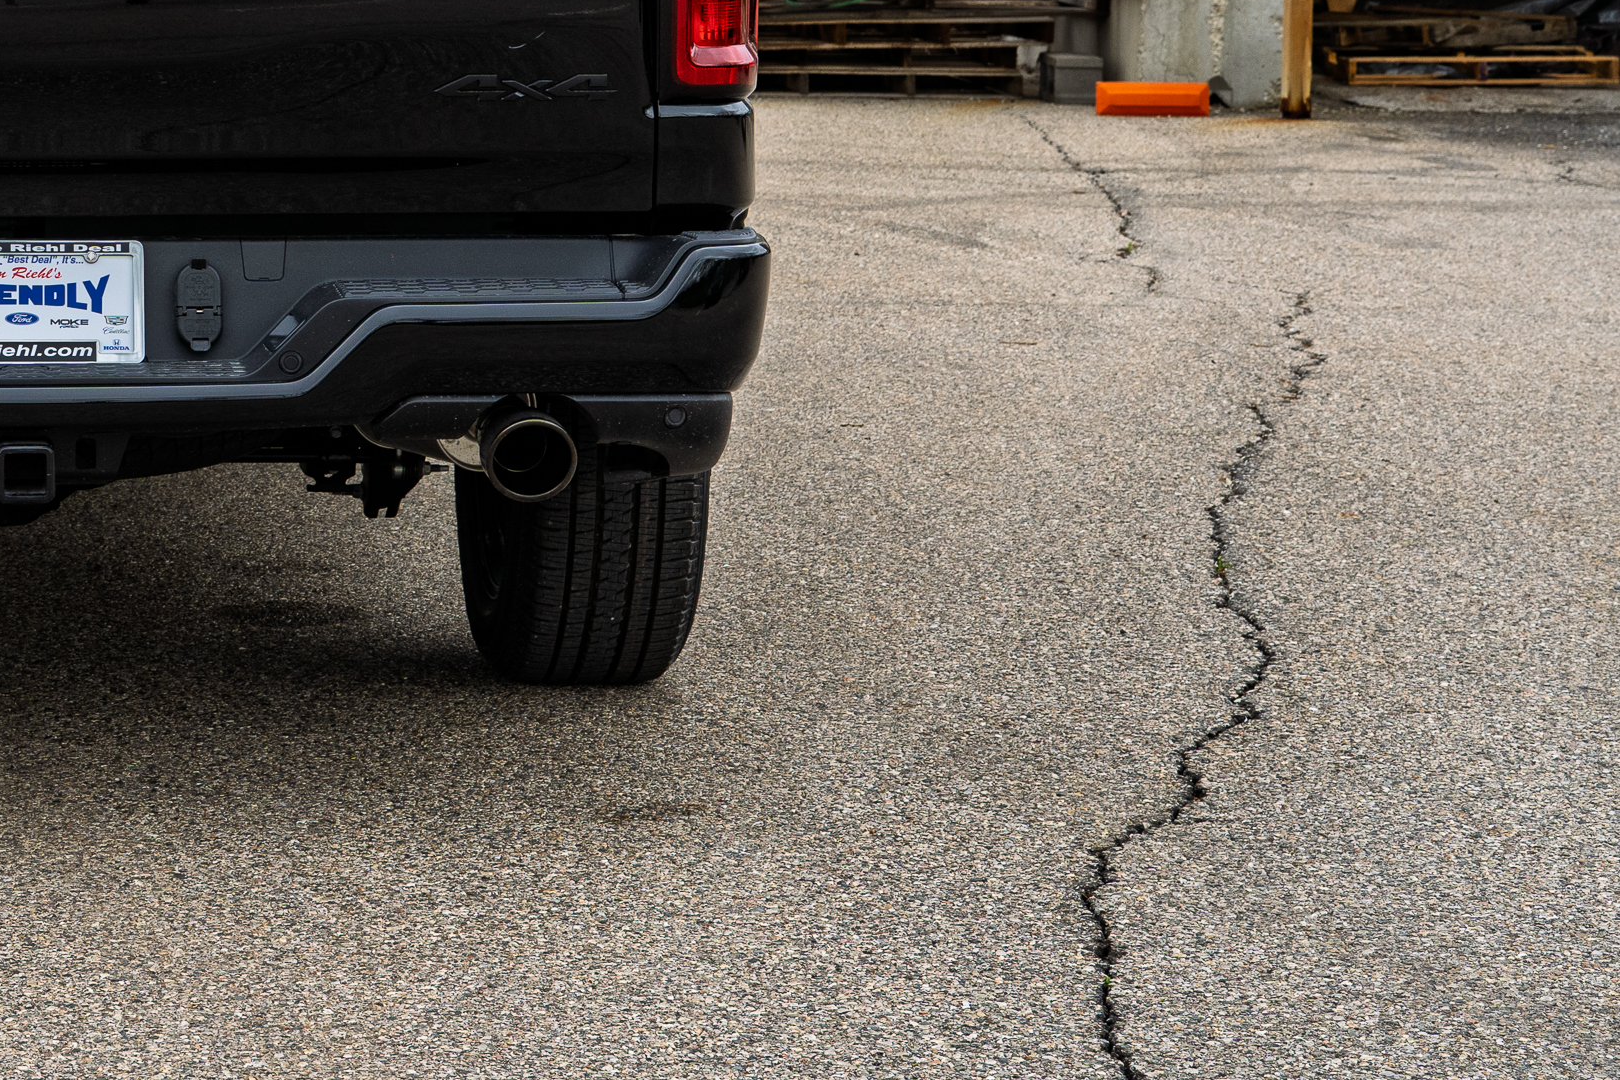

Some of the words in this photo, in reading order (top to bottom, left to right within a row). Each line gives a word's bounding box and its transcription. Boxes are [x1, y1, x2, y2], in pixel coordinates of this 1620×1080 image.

[10, 243, 66, 252] Riehl
[73, 243, 122, 252] Deal
[11, 266, 63, 279] Riehl's
[11, 313, 33, 323] Ford
[50, 318, 89, 326] MOKE
